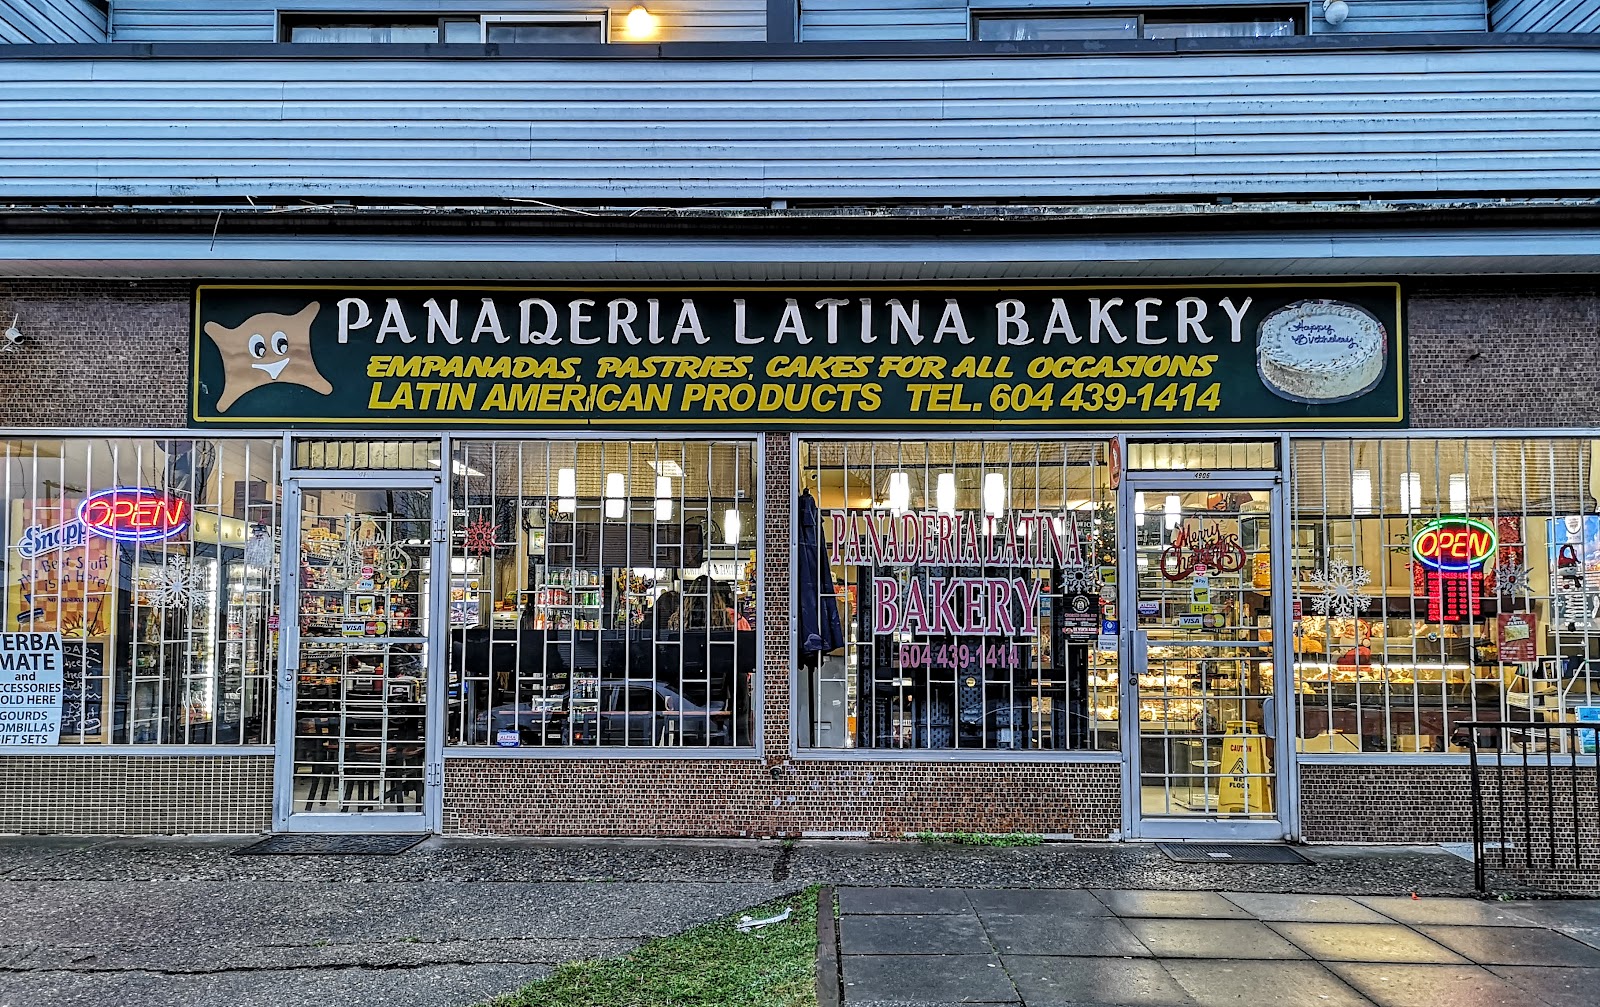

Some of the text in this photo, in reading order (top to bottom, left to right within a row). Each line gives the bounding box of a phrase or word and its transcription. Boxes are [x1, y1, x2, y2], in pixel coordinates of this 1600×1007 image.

[336, 297, 1254, 346] PANADERIA LATINA BAKERY
[1288, 319, 1335, 335] Happy
[1291, 334, 1359, 349] Birthday
[367, 355, 1219, 382] EMPANADAS, PASTRIES, CAKES FOR ALL OCCASIONS
[368, 382, 1221, 413] LATIN AMERICAN PRODUCTS TEL. 604 439-1414
[84, 500, 183, 526] OPEN
[22, 522, 87, 554] Snapp
[831, 508, 1084, 569] PANADERIA LATINA
[1182, 523, 1221, 546] Merry
[1418, 532, 1489, 557] OPEN
[76, 555, 108, 570] Suff
[874, 576, 1041, 637] BAKERY
[0, 633, 60, 651] ERBA
[901, 645, 1019, 668] 604 439-1414
[14, 671, 36, 681] and
[0, 683, 61, 693] CCESSORIES
[0, 695, 56, 705] OLD HERE
[0, 711, 48, 721] GOURDS
[0, 722, 55, 733] OMBILLAS
[0, 734, 48, 744] IFT SETS
[1230, 744, 1252, 752] CAUTN
